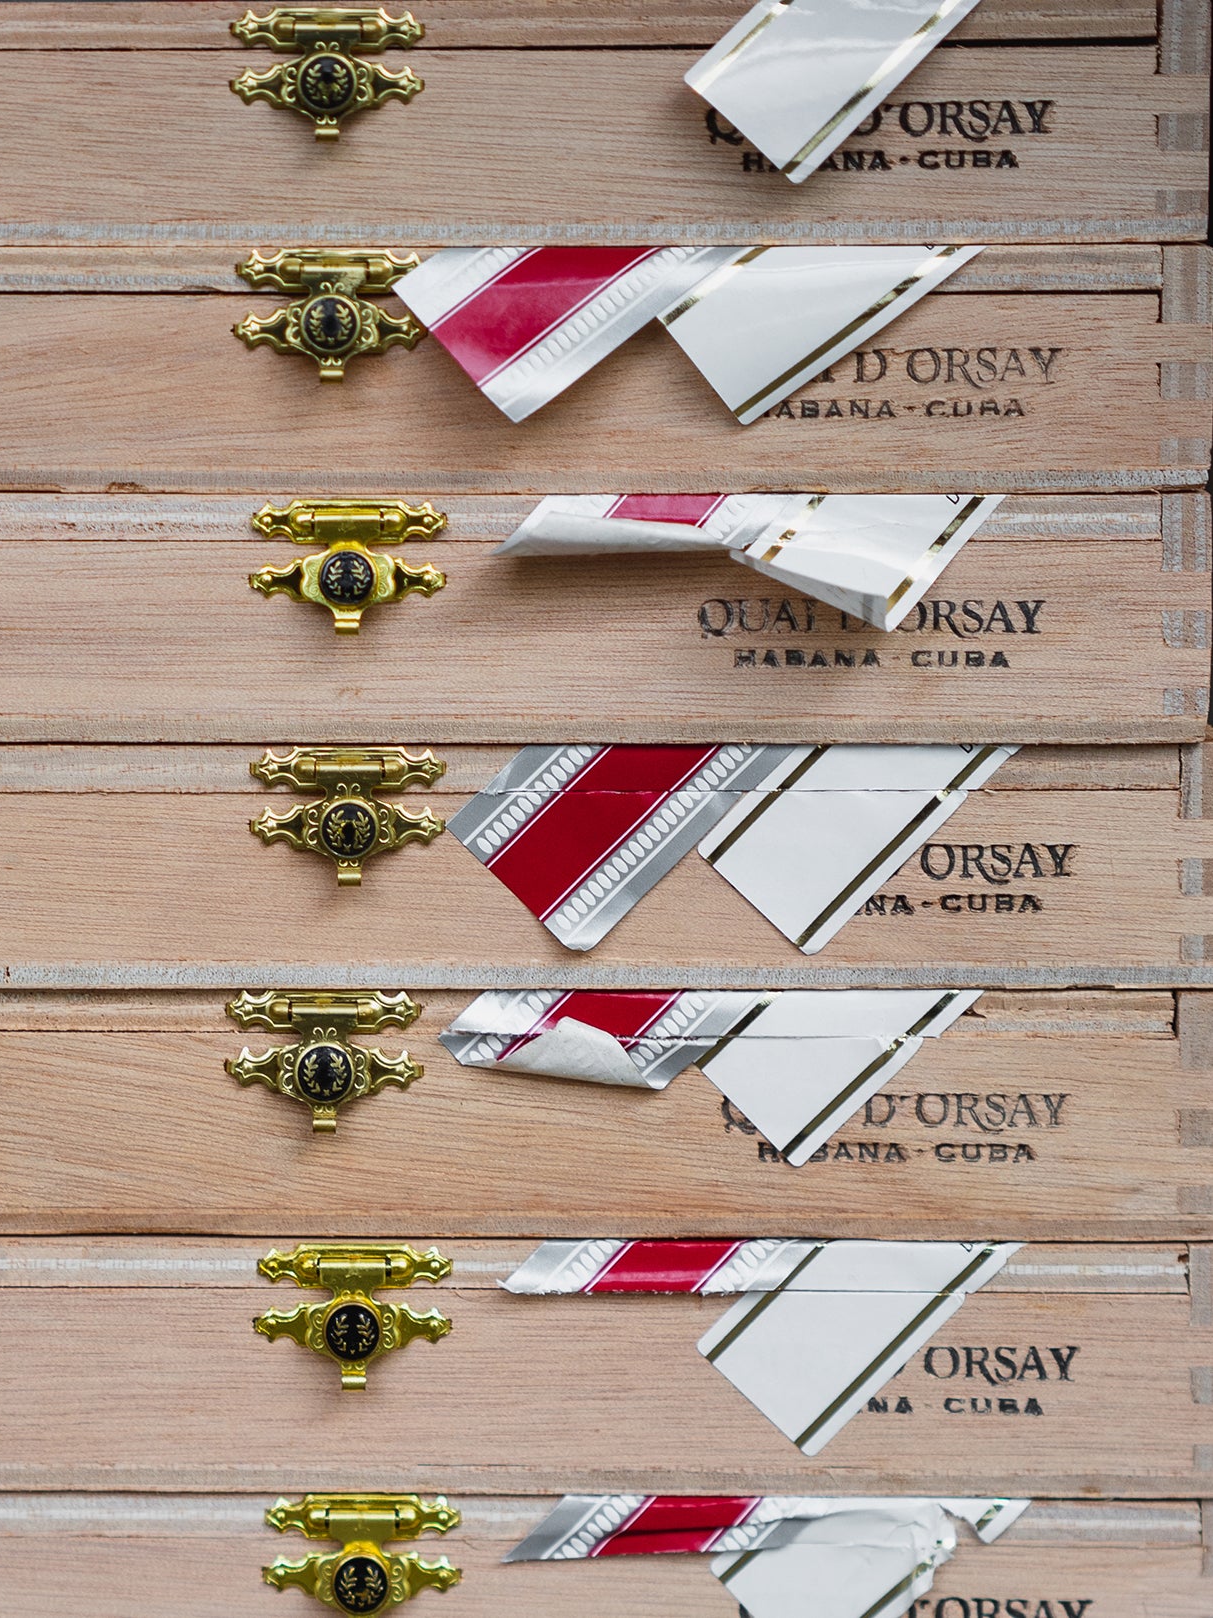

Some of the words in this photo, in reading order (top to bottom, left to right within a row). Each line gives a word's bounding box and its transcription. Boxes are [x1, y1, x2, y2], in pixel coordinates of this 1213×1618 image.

[742, 150, 892, 172] HANA
[918, 149, 1020, 170] CUBA
[763, 399, 897, 418] ABANA
[733, 648, 881, 668] HABANA
[911, 650, 1011, 669] CUBA
[889, 843, 1077, 885] ORSAY
[940, 894, 1043, 913] CUBA
[757, 1141, 906, 1163] HBANA
[934, 1142, 1037, 1163] CUBA
[894, 1346, 1080, 1386] ORSAY
[943, 1397, 1044, 1416] CUBA
[908, 1597, 1094, 1618] 'ORSAY
